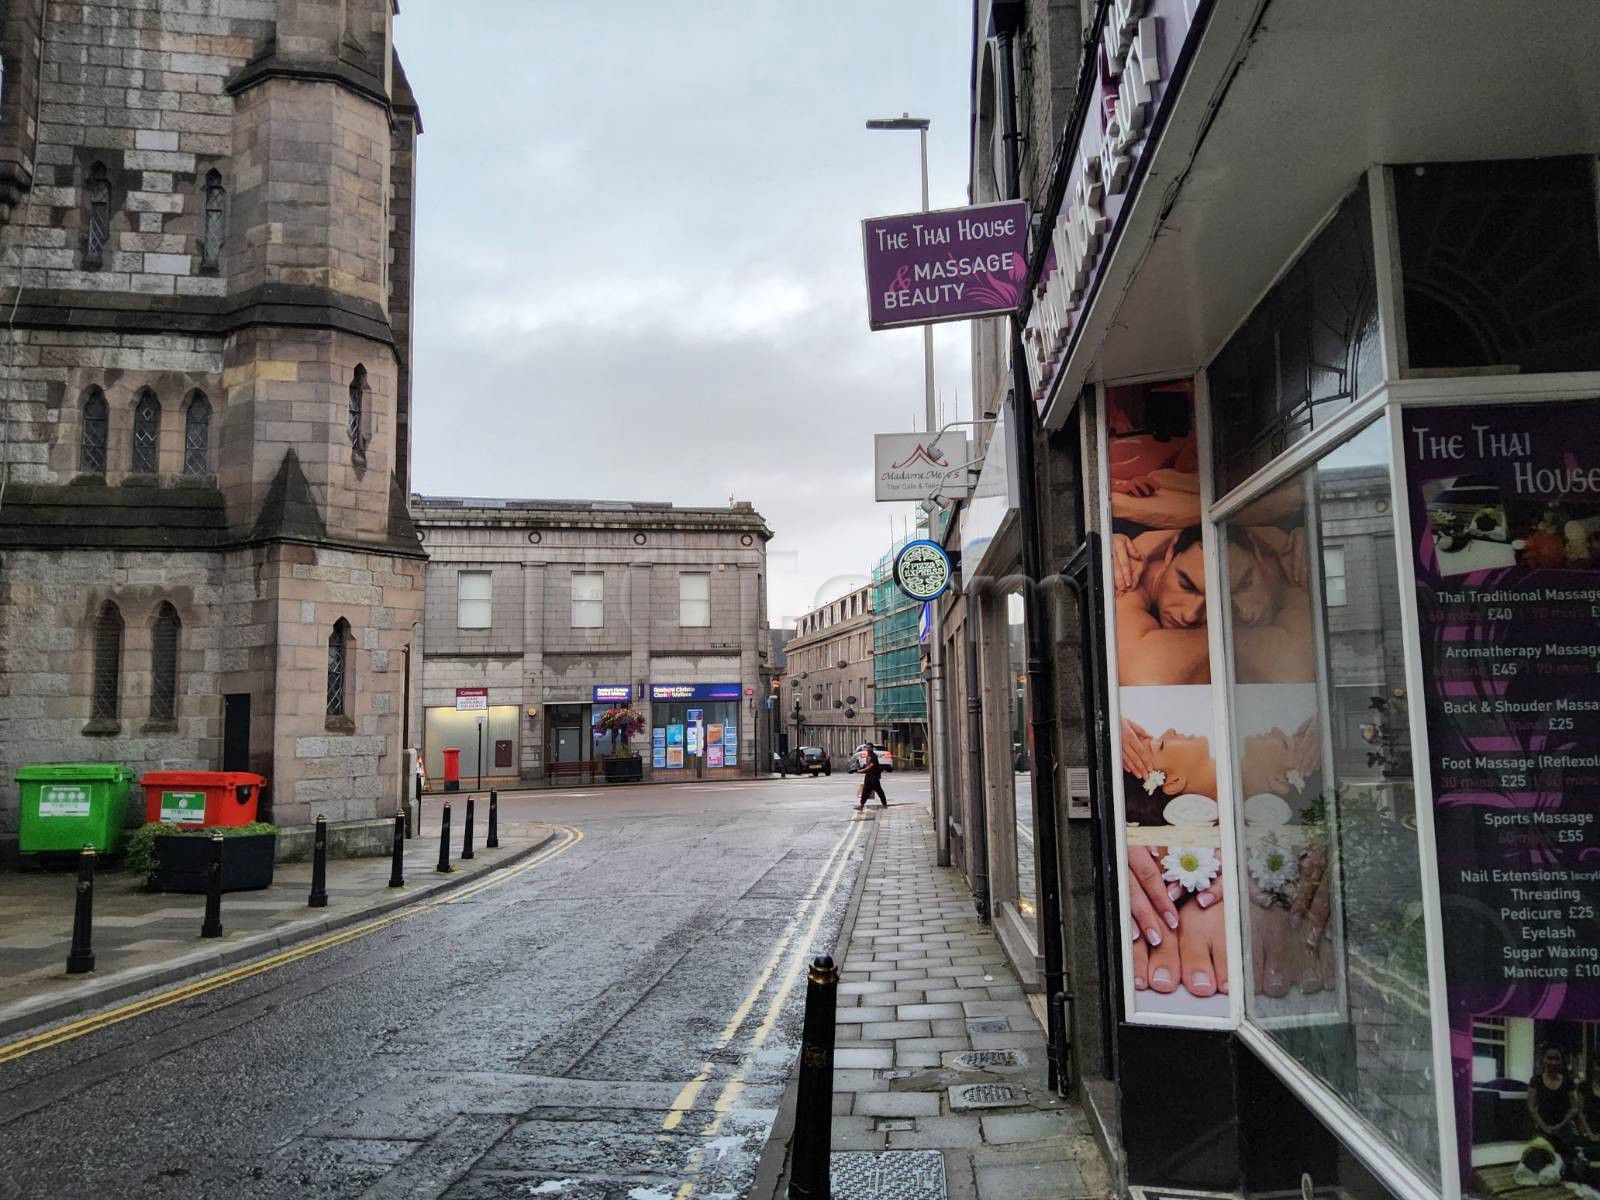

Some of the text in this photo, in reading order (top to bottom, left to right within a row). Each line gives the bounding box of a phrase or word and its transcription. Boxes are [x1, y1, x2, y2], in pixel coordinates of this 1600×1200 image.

[876, 218, 1016, 251] THE THAI HOUSE
[888, 252, 1014, 295] & MASSAGE
[883, 282, 965, 309] BEAUTY
[1412, 423, 1531, 461] THE THAI
[904, 567, 944, 577] EXPRESS
[911, 562, 936, 571] PIZZA
[1437, 591, 1465, 604] Thai
[1470, 589, 1542, 603] Traditional
[1488, 607, 1513, 620] £40
[1446, 645, 1542, 659] Aromatherapy
[1492, 663, 1517, 676] £45
[1444, 699, 1600, 714] Back & Shouder Massa
[1549, 718, 1574, 730] £25
[1442, 757, 1472, 770] Foot
[1475, 756, 1535, 771] Massage
[1501, 775, 1527, 788] £25
[1484, 811, 1593, 828] Sports Massage
[1558, 829, 1584, 842] £55
[1461, 870, 1489, 883] Nail
[1493, 869, 1568, 883] Extensions
[1511, 887, 1581, 902] Threading
[1501, 906, 1594, 920] Pedicure £25
[1522, 926, 1576, 940] Eyelash
[1503, 945, 1598, 961] Sugar Waxing
[1504, 964, 1600, 978] Manicure £10
